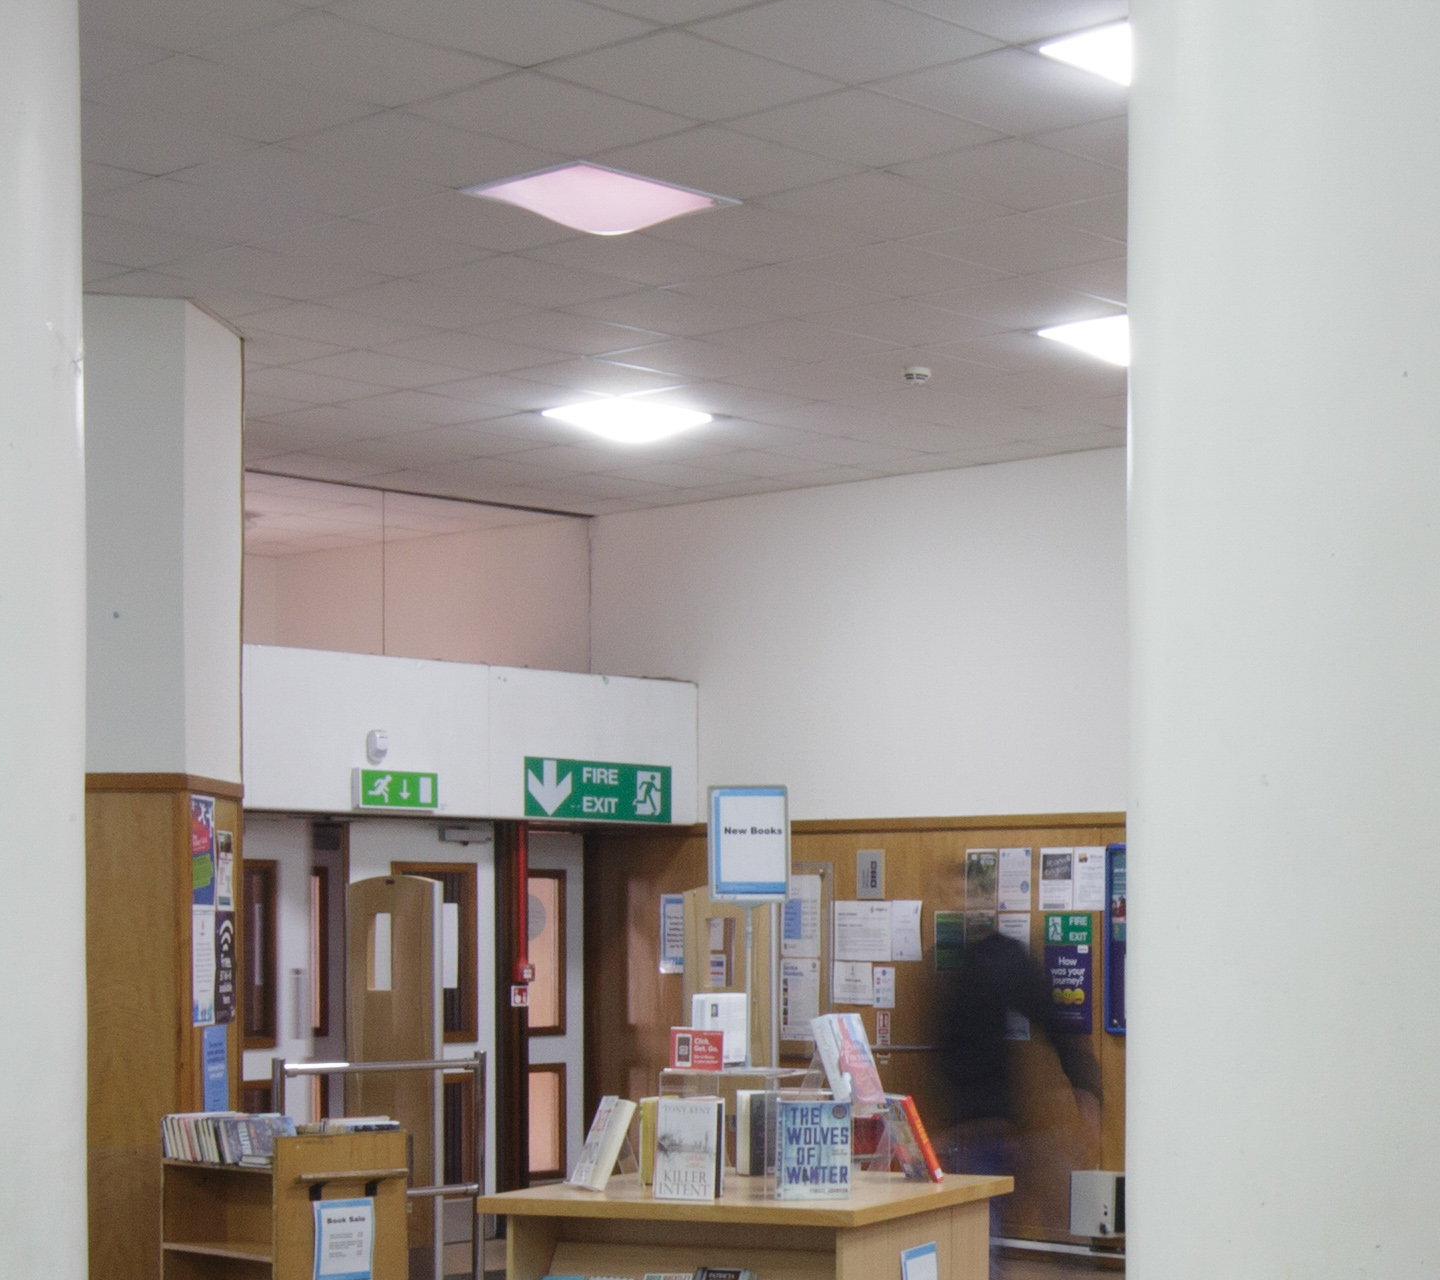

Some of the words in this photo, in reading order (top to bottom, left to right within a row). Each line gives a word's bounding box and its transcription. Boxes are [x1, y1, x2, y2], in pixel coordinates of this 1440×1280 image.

[582, 768, 619, 785] FIRE
[582, 797, 618, 815] EXIT
[723, 825, 746, 835] New
[750, 825, 783, 836] Books
[1068, 916, 1088, 926] FIRE
[1068, 931, 1088, 942] EXIT
[1058, 956, 1078, 966] How
[689, 1105, 711, 1115] KENT
[790, 1107, 821, 1126] THE
[786, 1126, 849, 1146] WOLVES
[796, 1146, 817, 1166] OF
[663, 1171, 707, 1184] KILLER
[659, 1183, 710, 1196] INTENT
[326, 1216, 347, 1225] Book
[348, 1215, 366, 1223] Sale
